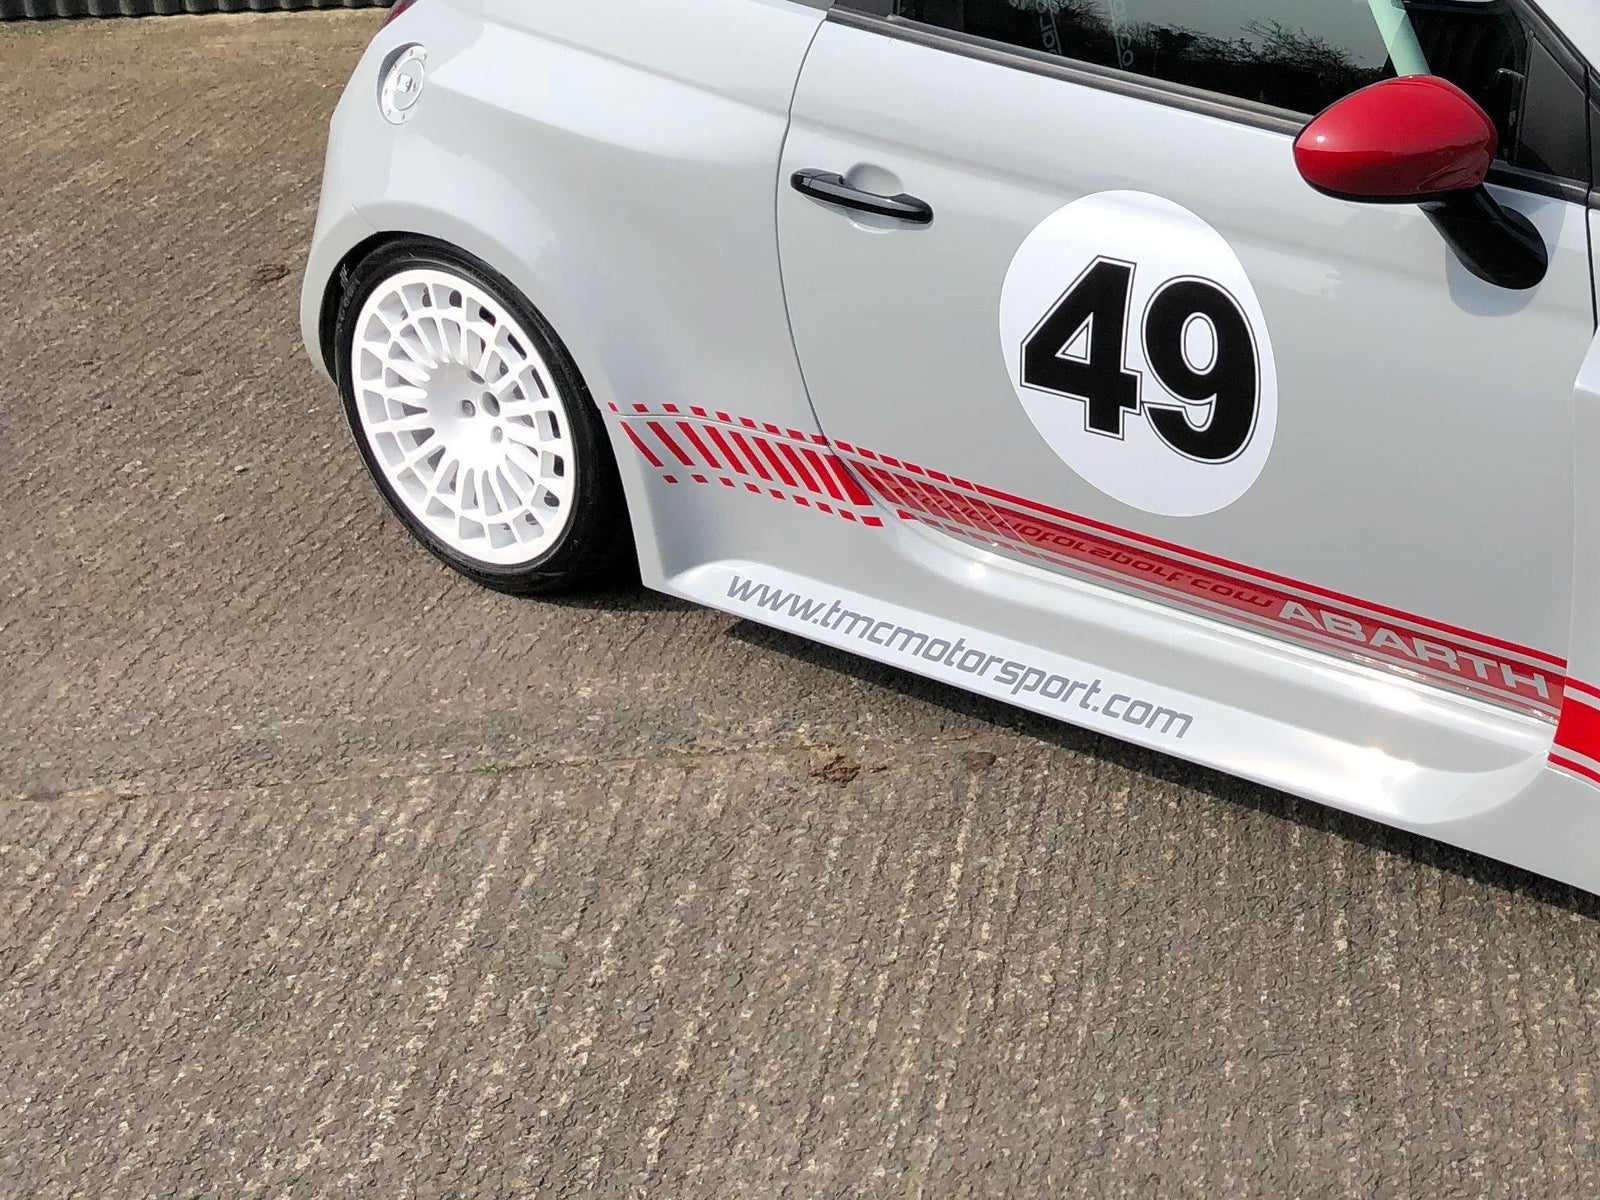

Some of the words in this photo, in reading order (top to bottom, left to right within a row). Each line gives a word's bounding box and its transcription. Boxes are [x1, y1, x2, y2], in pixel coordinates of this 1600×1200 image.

[1019, 253, 1261, 465] 49
[726, 575, 1194, 739] www.tmcmotorsport.com
[1276, 599, 1551, 700] ABARTH
